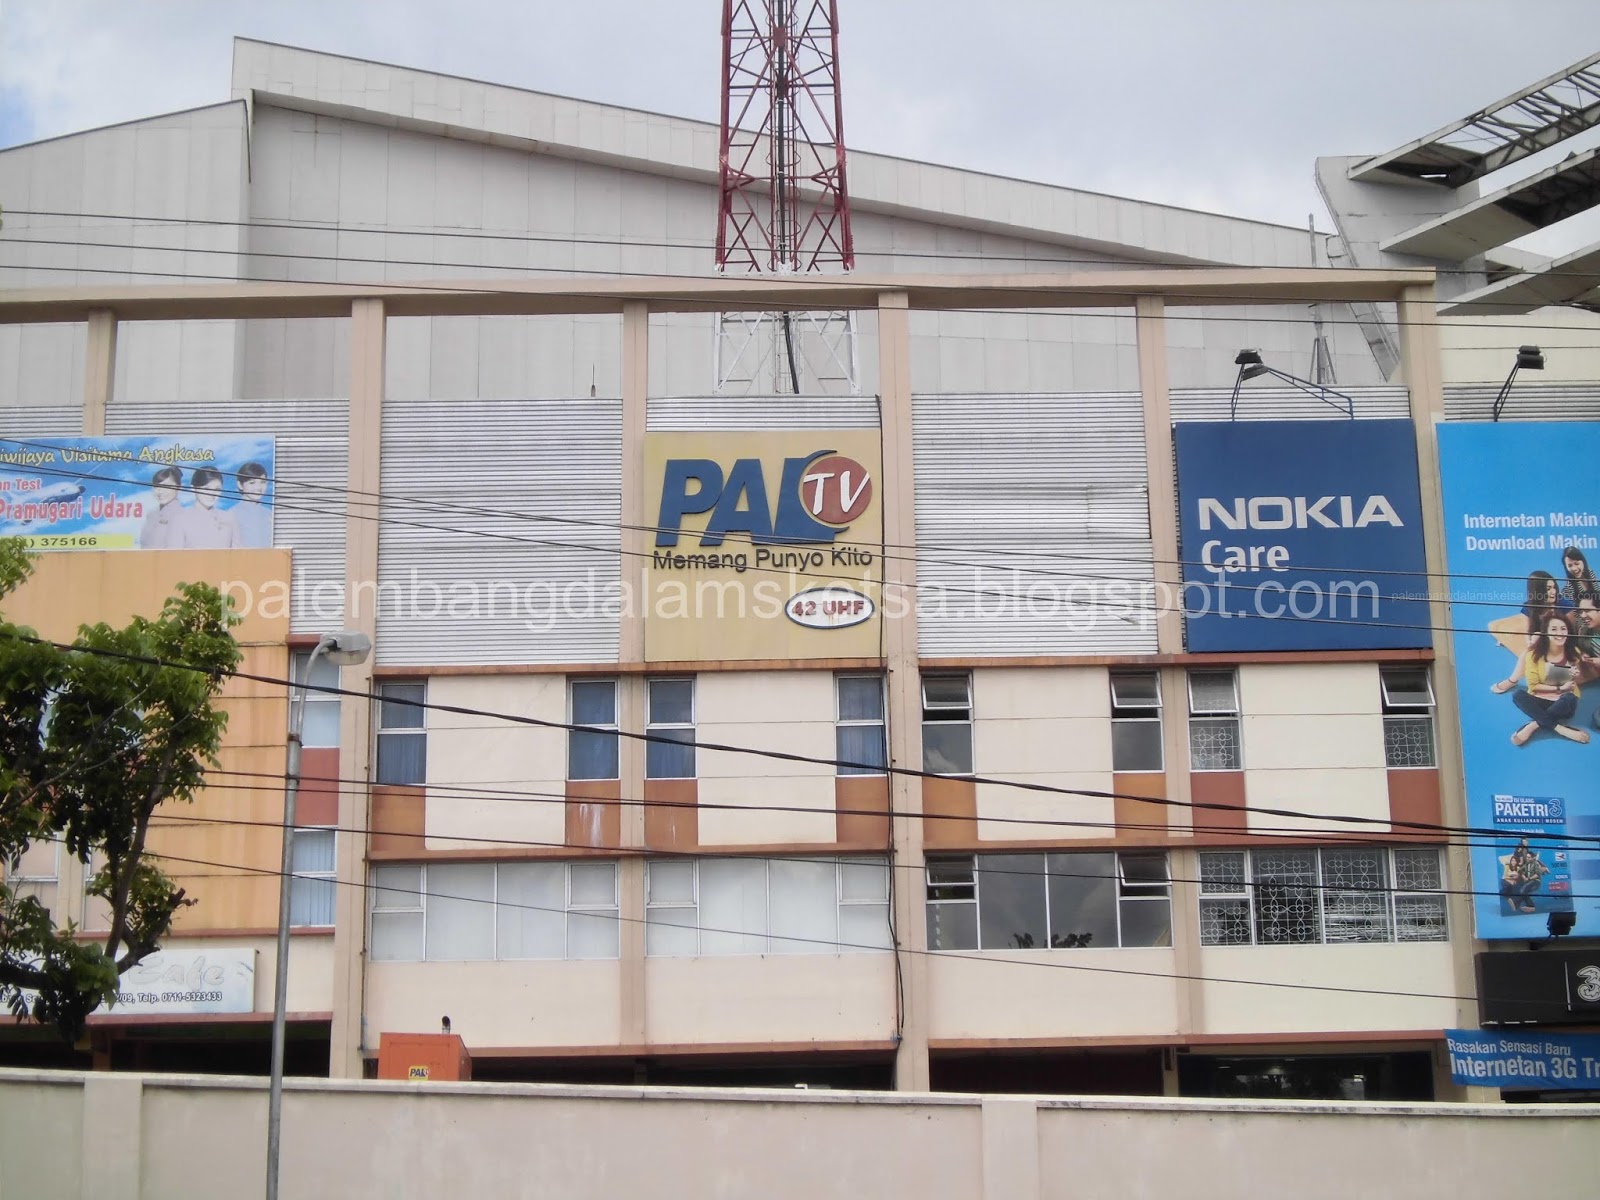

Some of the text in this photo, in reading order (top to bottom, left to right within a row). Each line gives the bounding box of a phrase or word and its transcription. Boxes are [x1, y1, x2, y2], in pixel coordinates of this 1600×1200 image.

[60, 447, 134, 463] Visitama
[137, 443, 215, 466] Angkasa
[15, 478, 42, 491] Test
[803, 470, 871, 515] TV
[90, 493, 143, 519] Udara
[1198, 495, 1404, 530] NOKIA
[1464, 512, 1598, 529] Internetan Makin
[40, 537, 97, 547] 375166
[1466, 534, 1598, 551] Download Makin
[653, 546, 873, 572] Memang Punyo Kito
[1201, 539, 1291, 573] Care
[792, 600, 865, 616] 42 UHF
[137, 993, 159, 1005] Telp.
[161, 992, 223, 1003] 0711-5323433
[1447, 1039, 1571, 1056] Rasakan Sensasi Baru
[1450, 1053, 1547, 1078] Internetan
[1551, 1057, 1577, 1079] 3G
